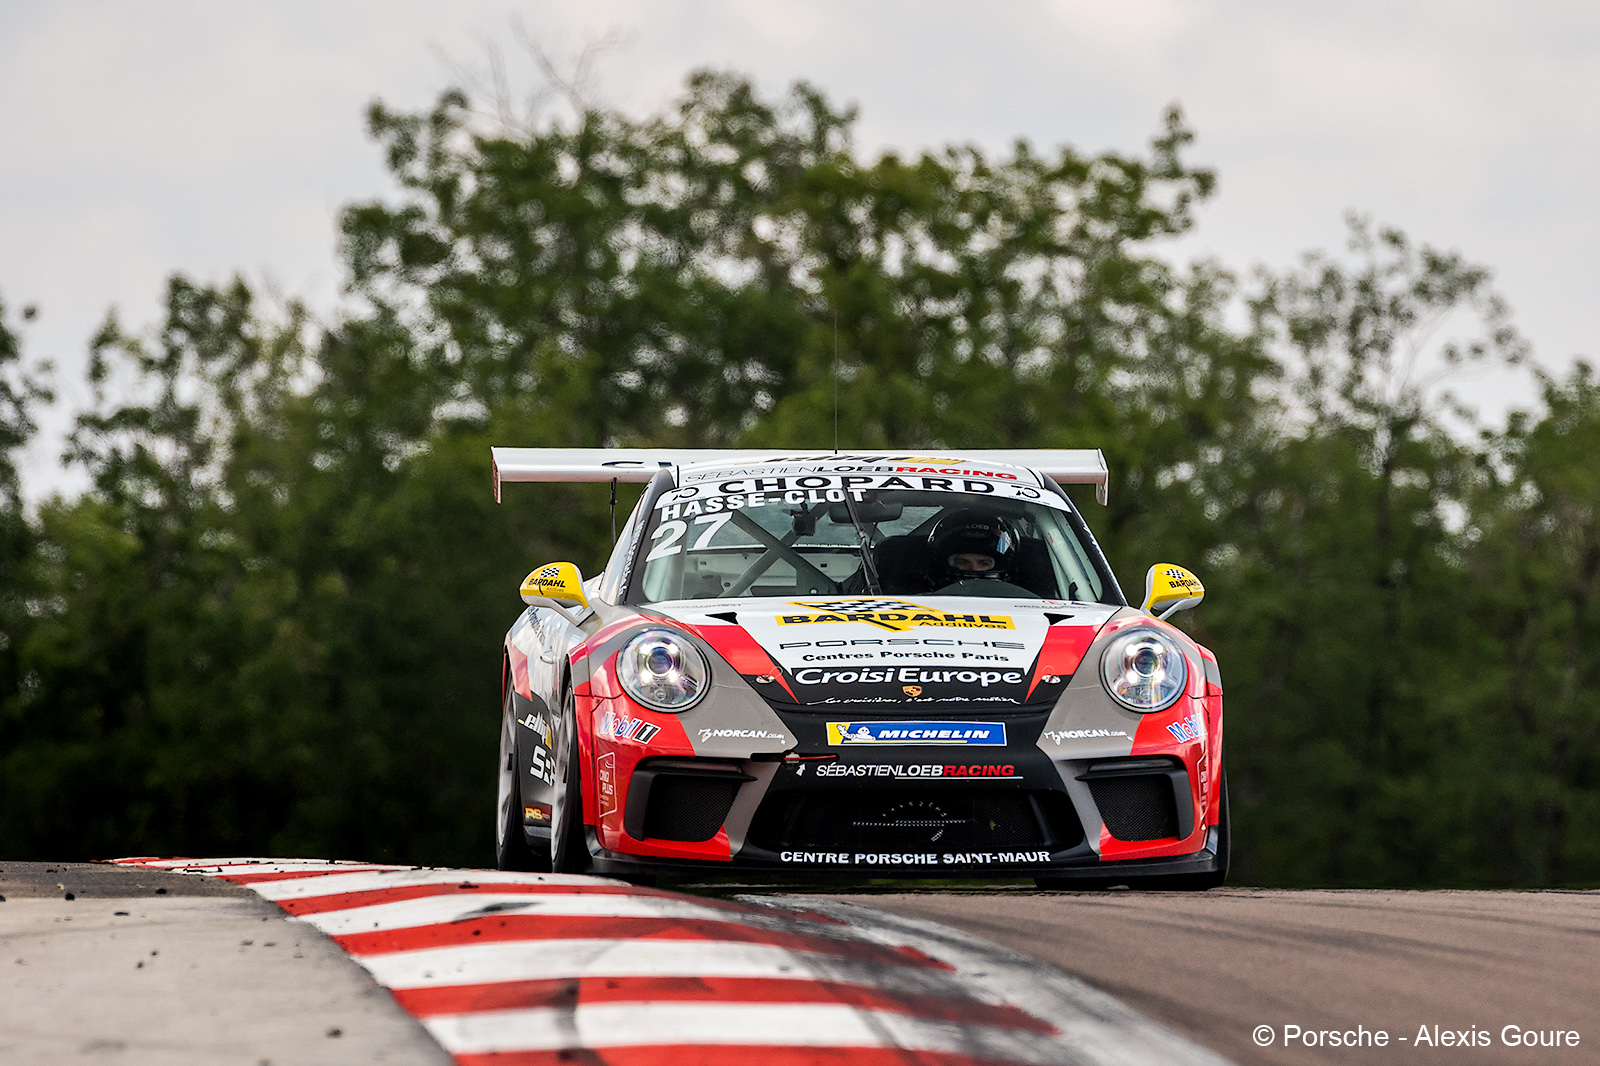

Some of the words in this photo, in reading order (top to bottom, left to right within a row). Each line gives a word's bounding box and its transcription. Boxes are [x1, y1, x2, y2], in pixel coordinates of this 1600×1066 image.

[718, 476, 995, 494] CHOPARD
[660, 488, 867, 523] HASSE-CLOT
[646, 512, 734, 563] 27
[782, 612, 1007, 626] BARDAHL
[919, 621, 1008, 629] Additives
[779, 638, 1026, 650] PORSCHE
[802, 653, 874, 661] Centres
[880, 651, 955, 659] Porsche
[961, 652, 1009, 661] Paris
[878, 728, 990, 740] MICHELIN
[780, 851, 850, 864] CENTRE
[854, 852, 938, 865] PORSCHE
[942, 851, 1052, 865] SAINT-MAUR
